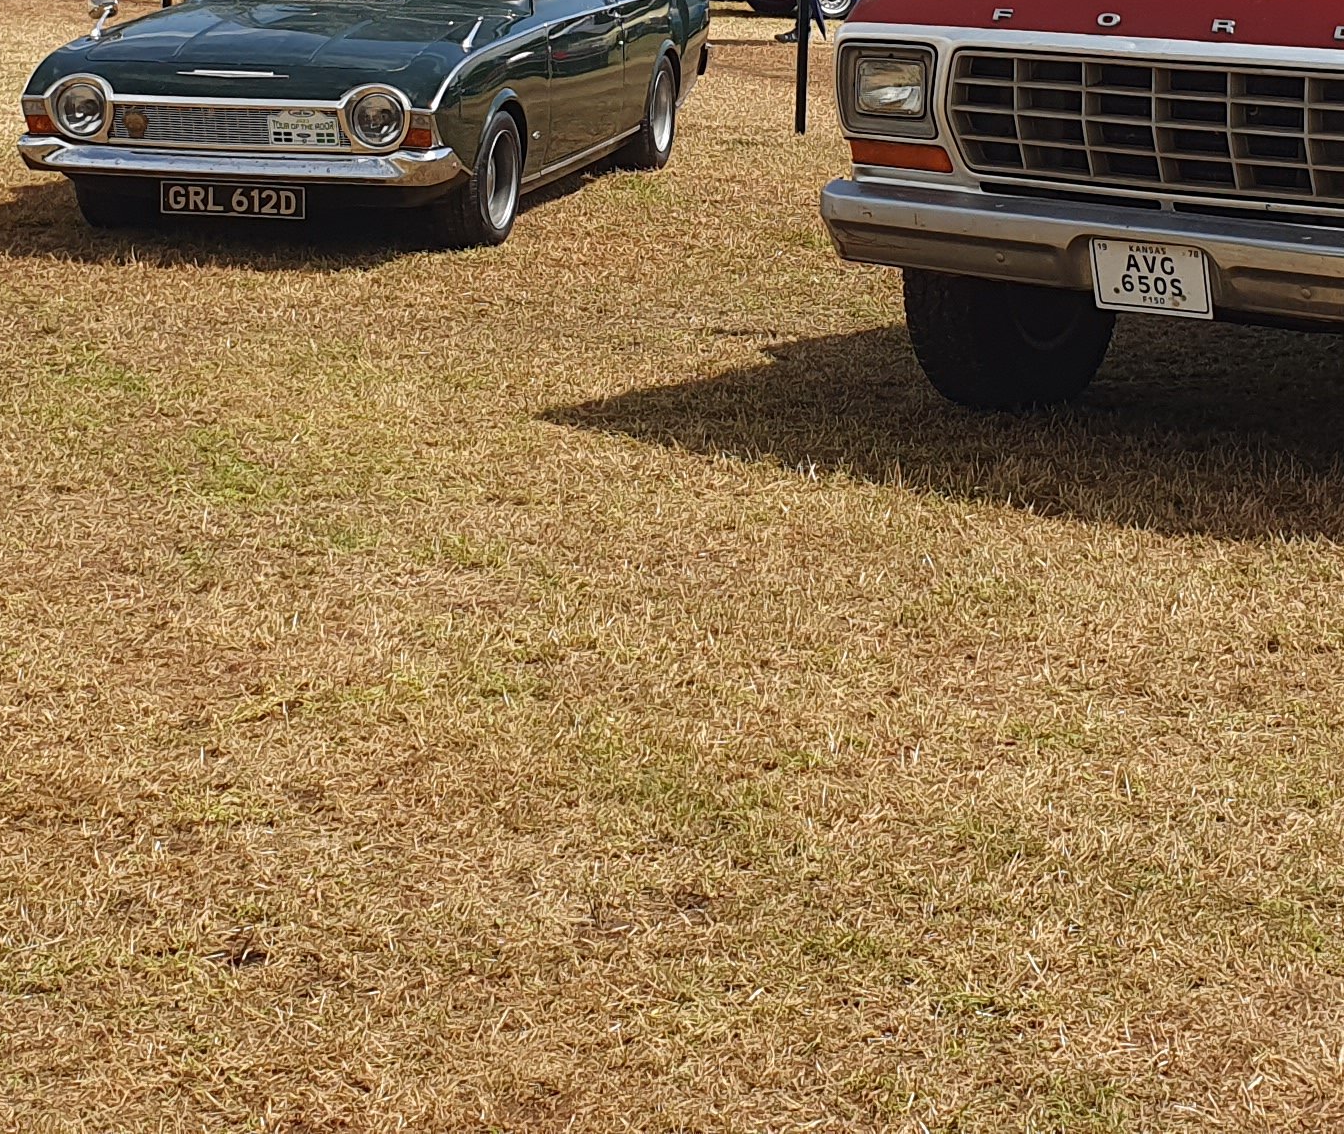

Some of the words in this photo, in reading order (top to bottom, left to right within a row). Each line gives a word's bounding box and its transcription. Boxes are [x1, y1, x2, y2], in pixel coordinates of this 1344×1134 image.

[301, 123, 313, 131] THE
[168, 185, 224, 211] GRL
[231, 188, 297, 215] 612D
[1097, 242, 1108, 251] 19
[1129, 245, 1167, 255] KANSAS
[1126, 254, 1175, 276] AVG
[1121, 274, 1183, 297] 650S
[1142, 296, 1165, 305] F150
